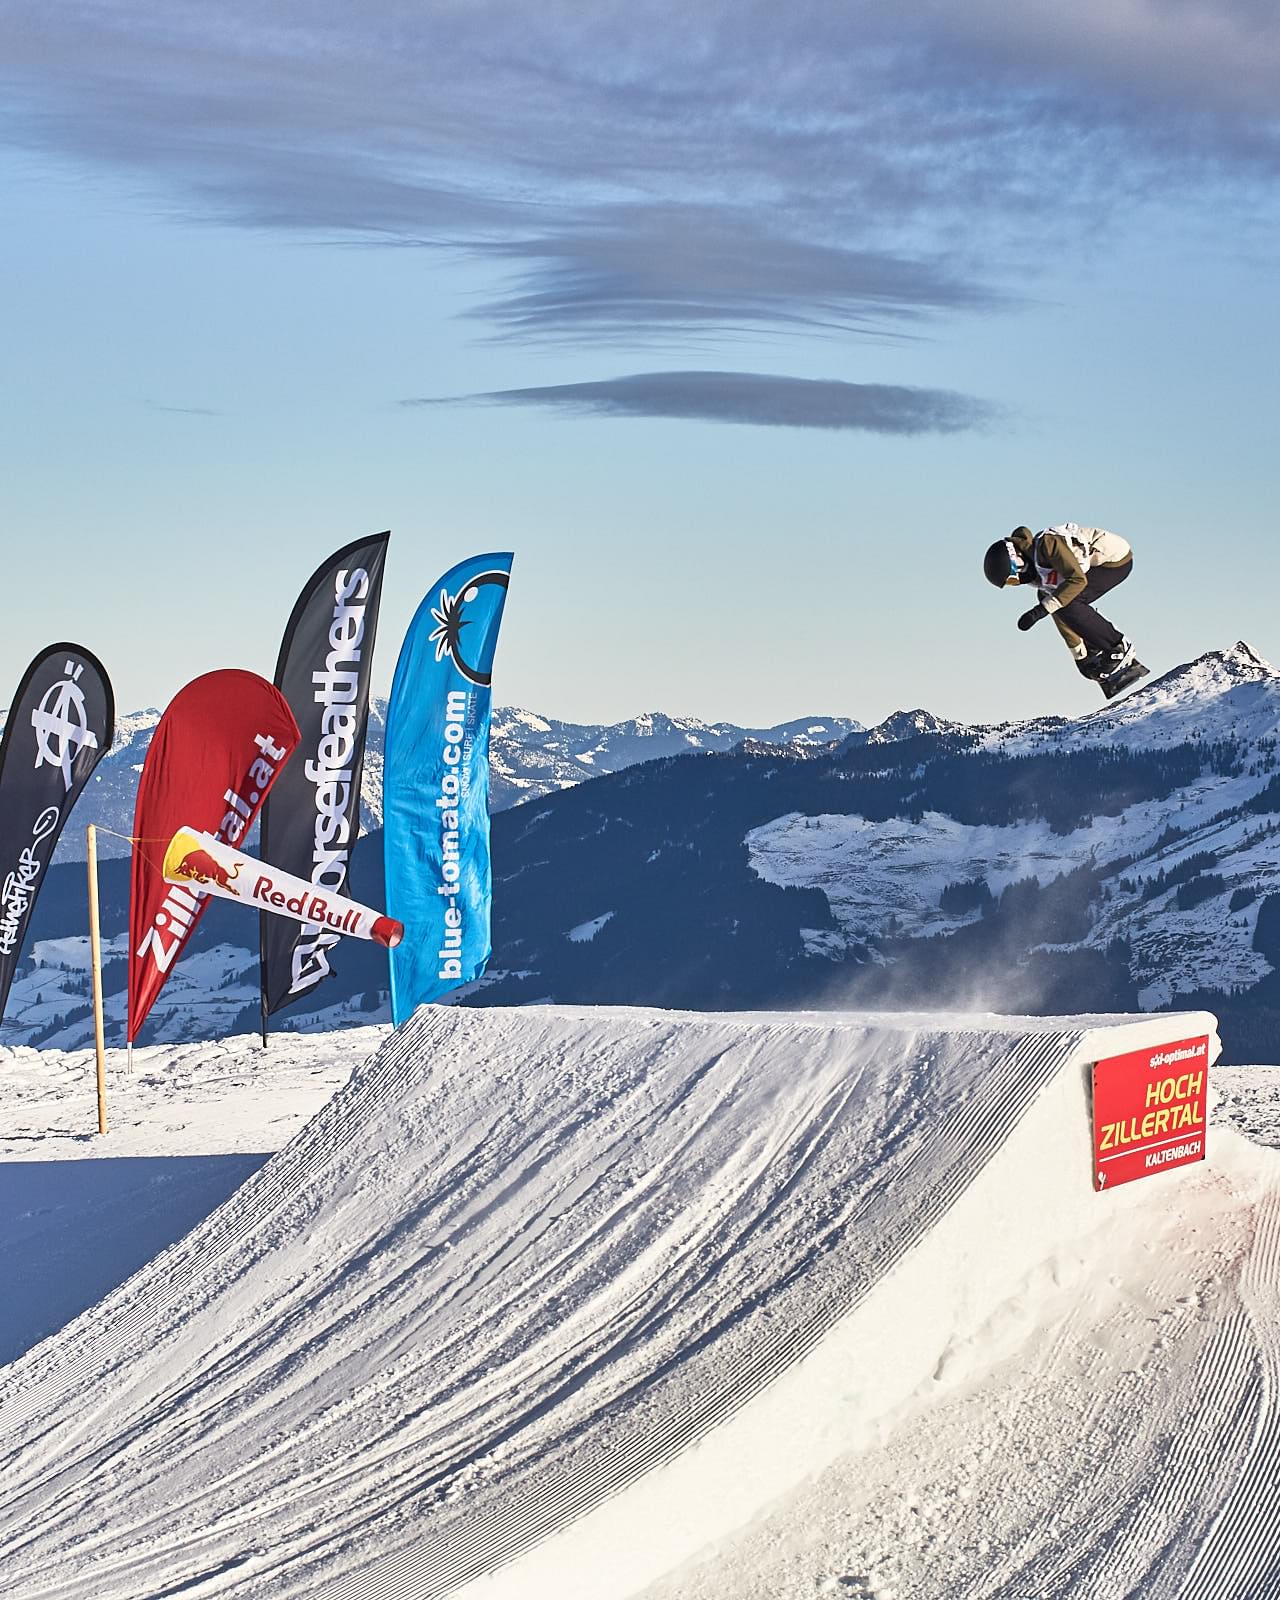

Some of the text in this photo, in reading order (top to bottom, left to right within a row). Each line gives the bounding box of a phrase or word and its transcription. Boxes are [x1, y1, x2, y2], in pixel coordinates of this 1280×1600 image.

[466, 692, 478, 725] SKATE
[462, 733, 474, 761] SURF
[136, 733, 286, 974] Zillal.at
[436, 690, 466, 980] blue-tomato.com
[1144, 1070, 1203, 1108] HOCH
[1099, 1101, 1203, 1152] ZILLERTAL
[1144, 1140, 1202, 1168] KALTENBACH
